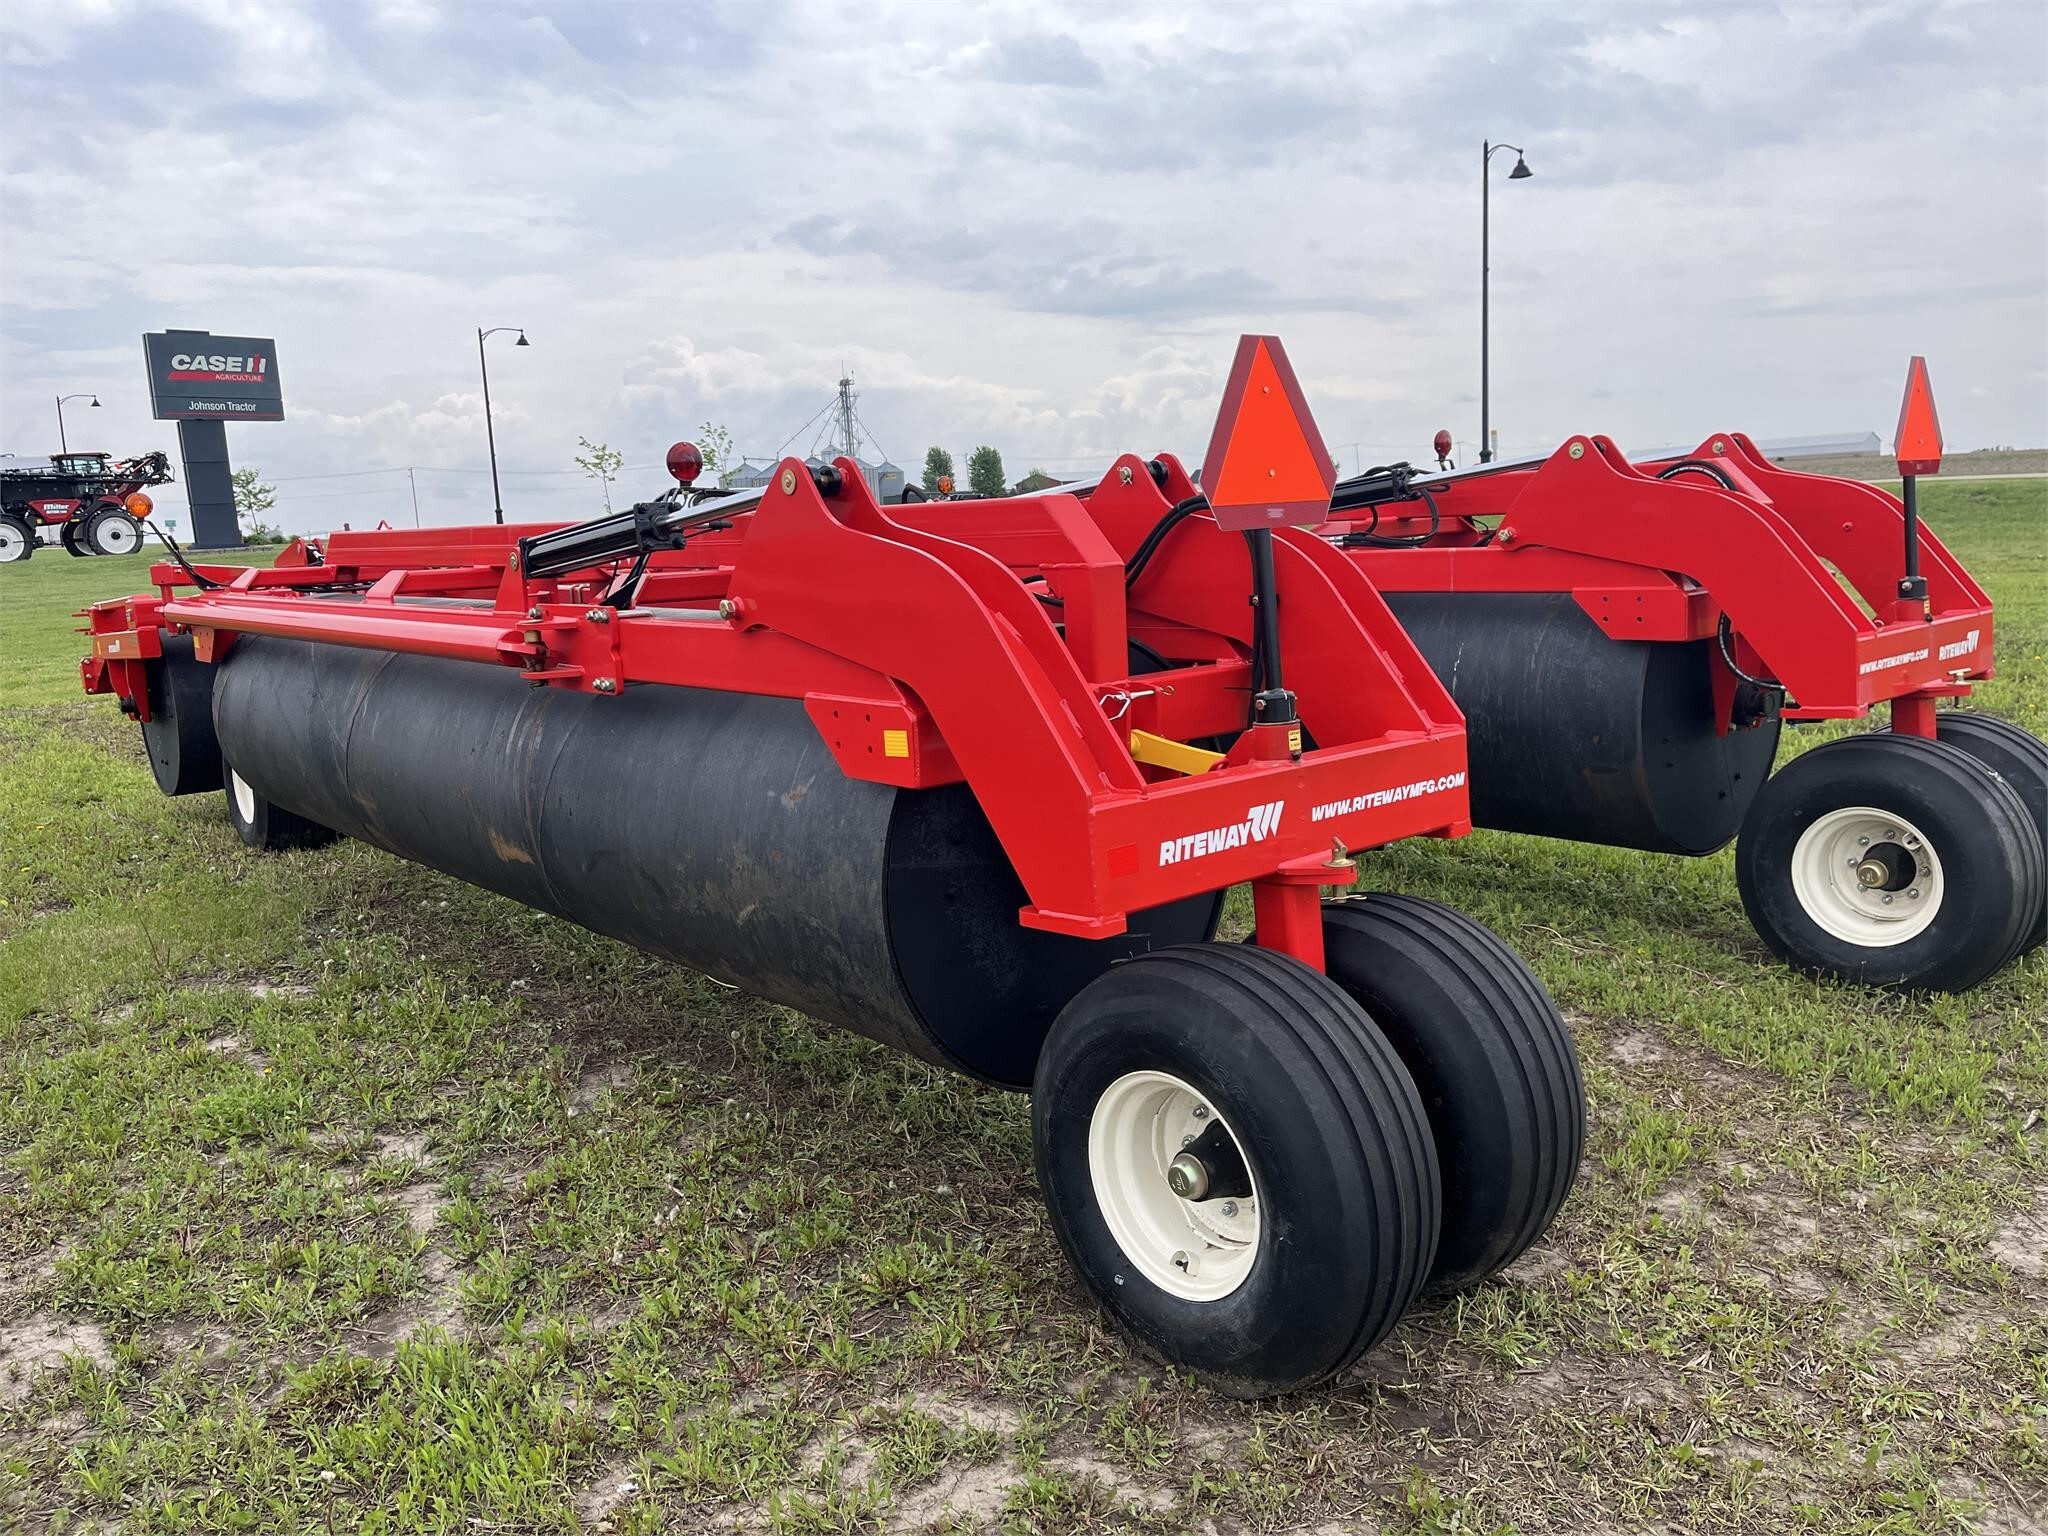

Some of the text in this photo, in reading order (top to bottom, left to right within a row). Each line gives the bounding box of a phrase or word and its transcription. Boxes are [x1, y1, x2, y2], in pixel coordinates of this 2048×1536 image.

[171, 354, 242, 372] CASE
[215, 374, 263, 382] AGRICULTURE
[188, 401, 256, 412] Johnson Tractor
[1159, 772, 1466, 867] RITEWAY WWW.RITEWAYMFG.COM
